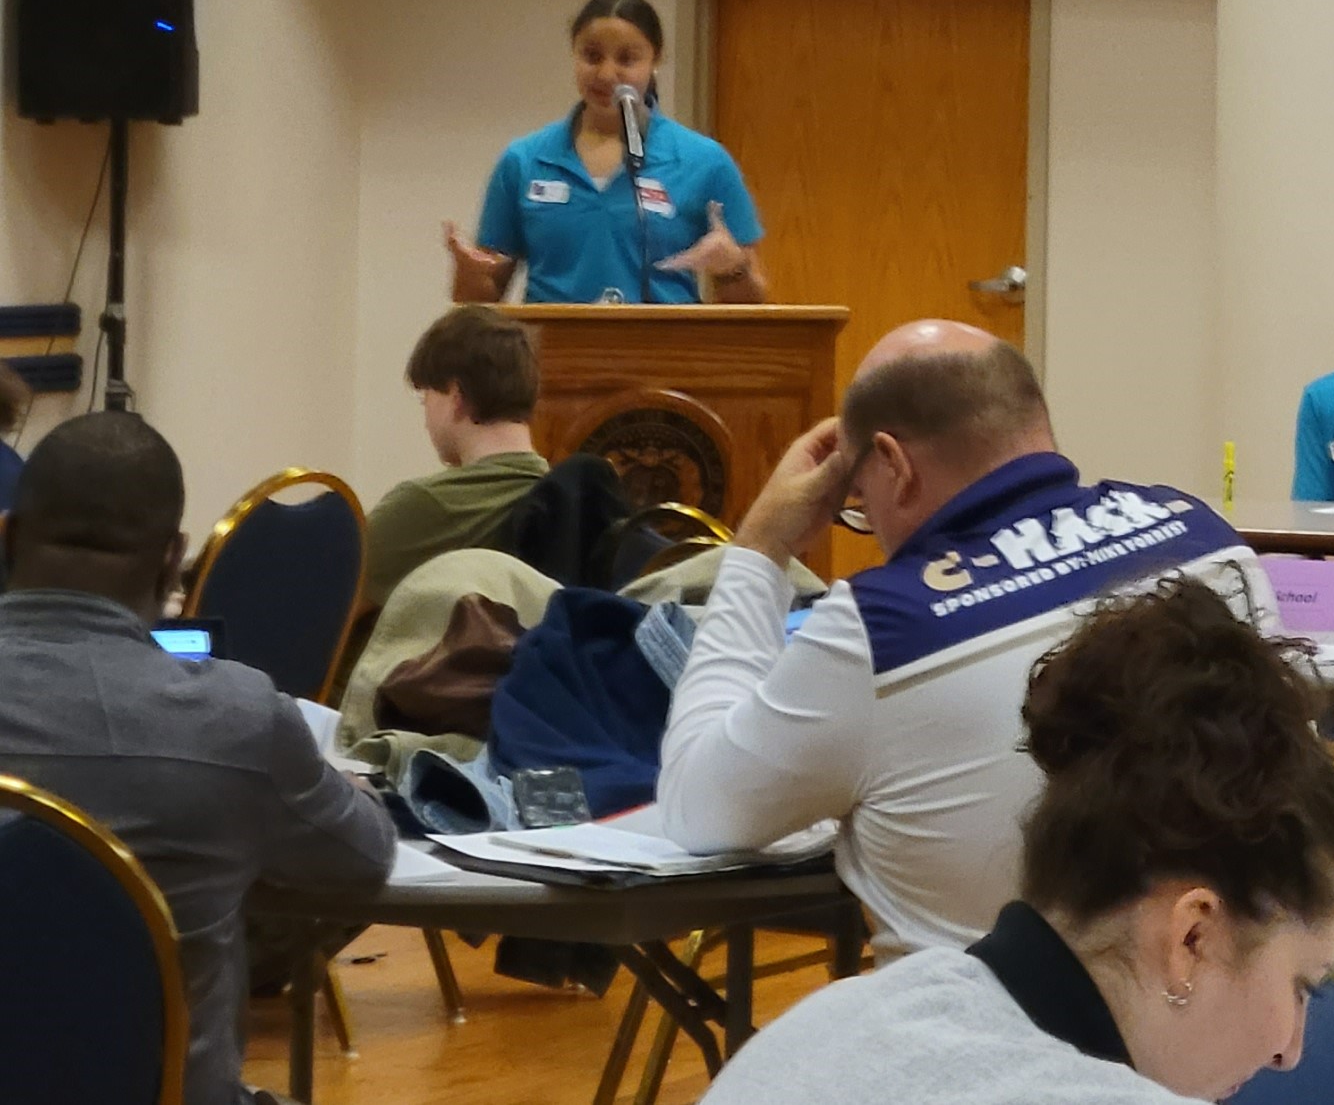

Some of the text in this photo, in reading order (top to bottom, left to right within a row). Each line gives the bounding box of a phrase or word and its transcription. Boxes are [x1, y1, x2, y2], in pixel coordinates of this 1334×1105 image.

[929, 566, 1057, 617] SPONSORED
[1051, 556, 1089, 576] BY:
[1083, 542, 1130, 566] MIKE
